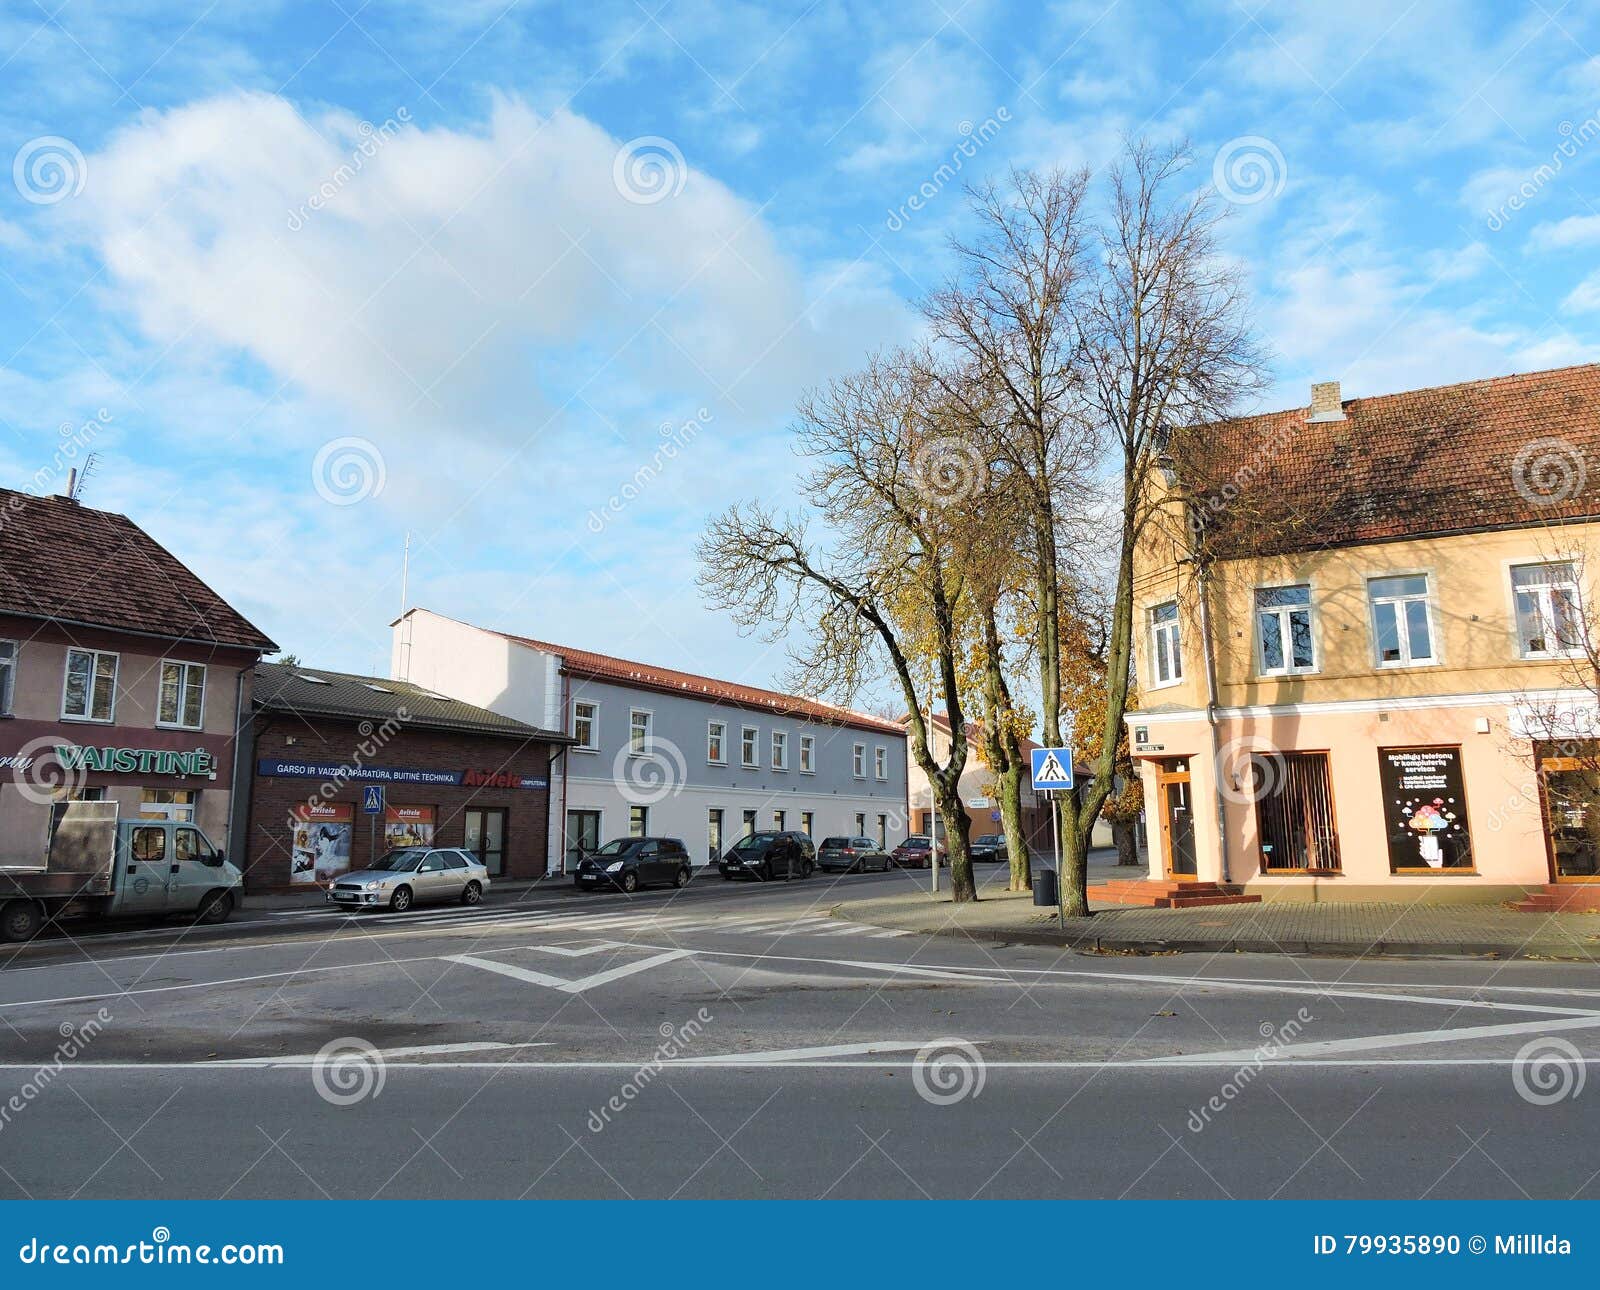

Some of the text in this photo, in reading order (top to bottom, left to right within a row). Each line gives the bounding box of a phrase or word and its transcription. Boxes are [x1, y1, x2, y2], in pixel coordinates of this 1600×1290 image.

[53, 744, 211, 775] VAISTINĖ
[276, 764, 306, 774] GARSO
[307, 767, 316, 775] IR
[318, 767, 347, 776] VAIZDO
[347, 769, 392, 779] APARATŪRA,
[393, 771, 420, 780] BUITINĖ
[421, 773, 454, 782] TECHNIKA
